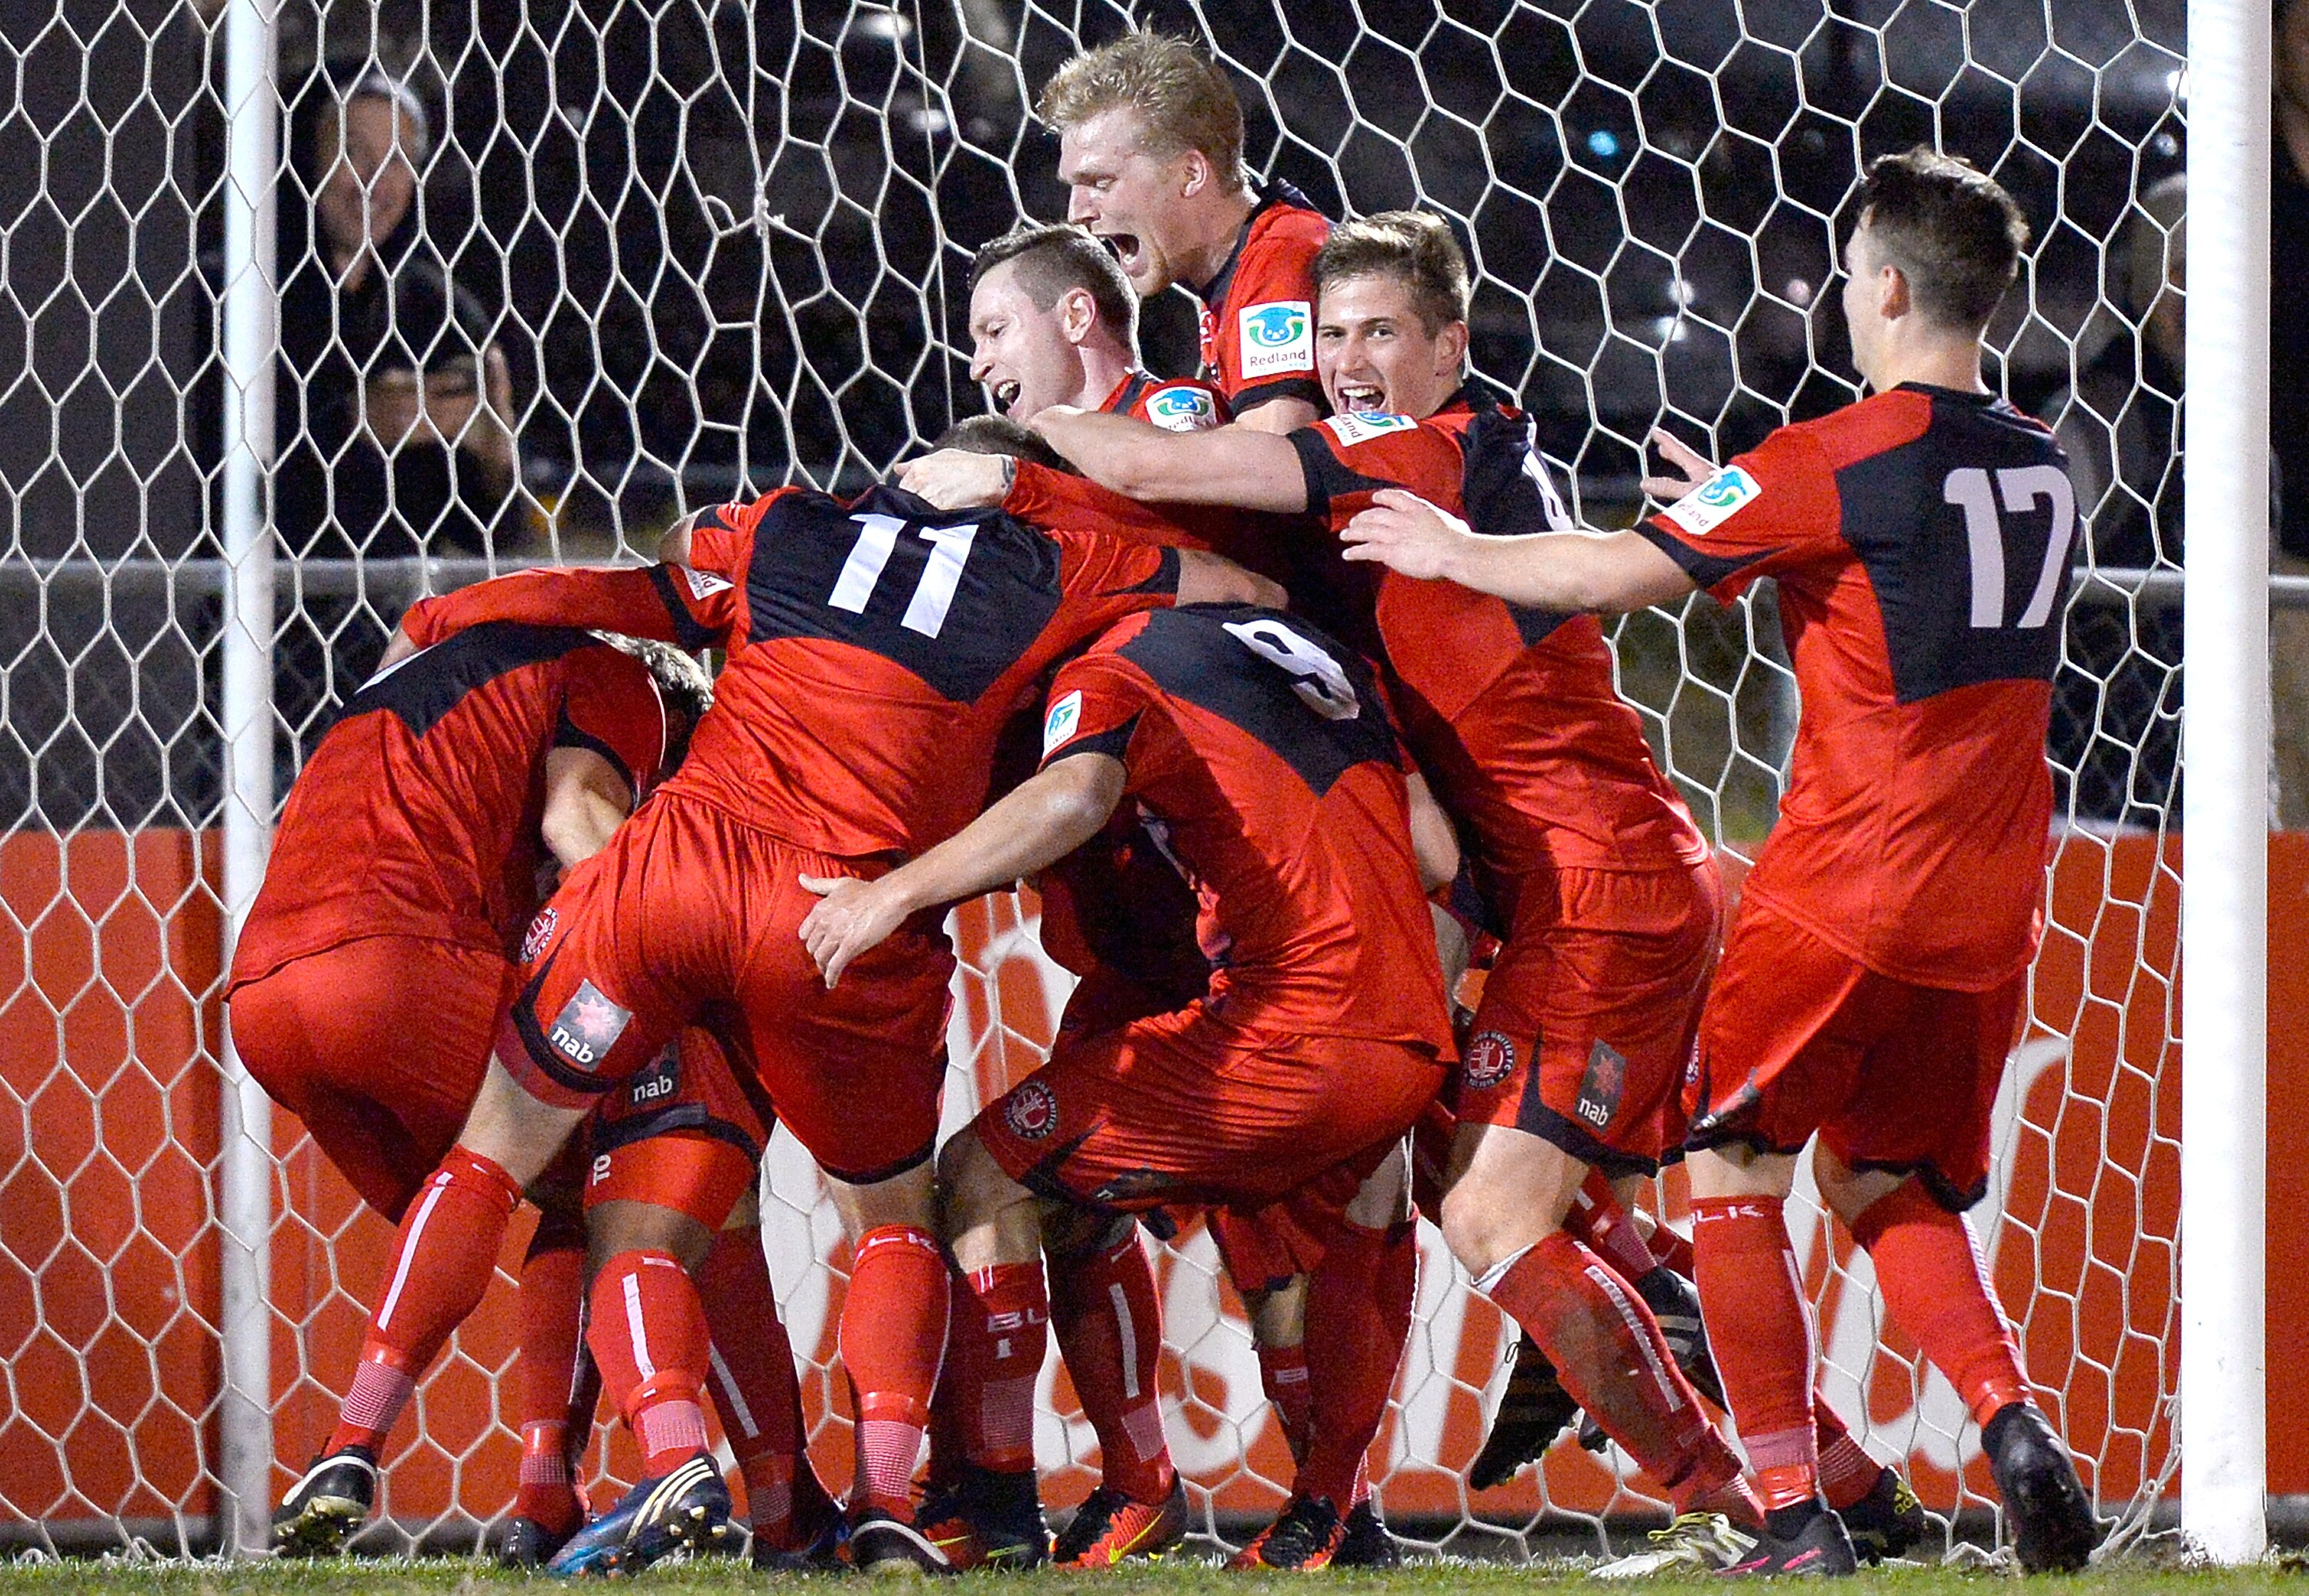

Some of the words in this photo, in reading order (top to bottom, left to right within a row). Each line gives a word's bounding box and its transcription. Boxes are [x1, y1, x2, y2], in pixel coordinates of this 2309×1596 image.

[1250, 349, 1307, 367] Redland
[1943, 465, 2075, 629] 17
[828, 513, 979, 639] 11
[1221, 619, 1362, 721] 9
[551, 1026, 594, 1063] nab
[633, 1075, 673, 1103] nab
[1578, 1097, 1609, 1127] nab
